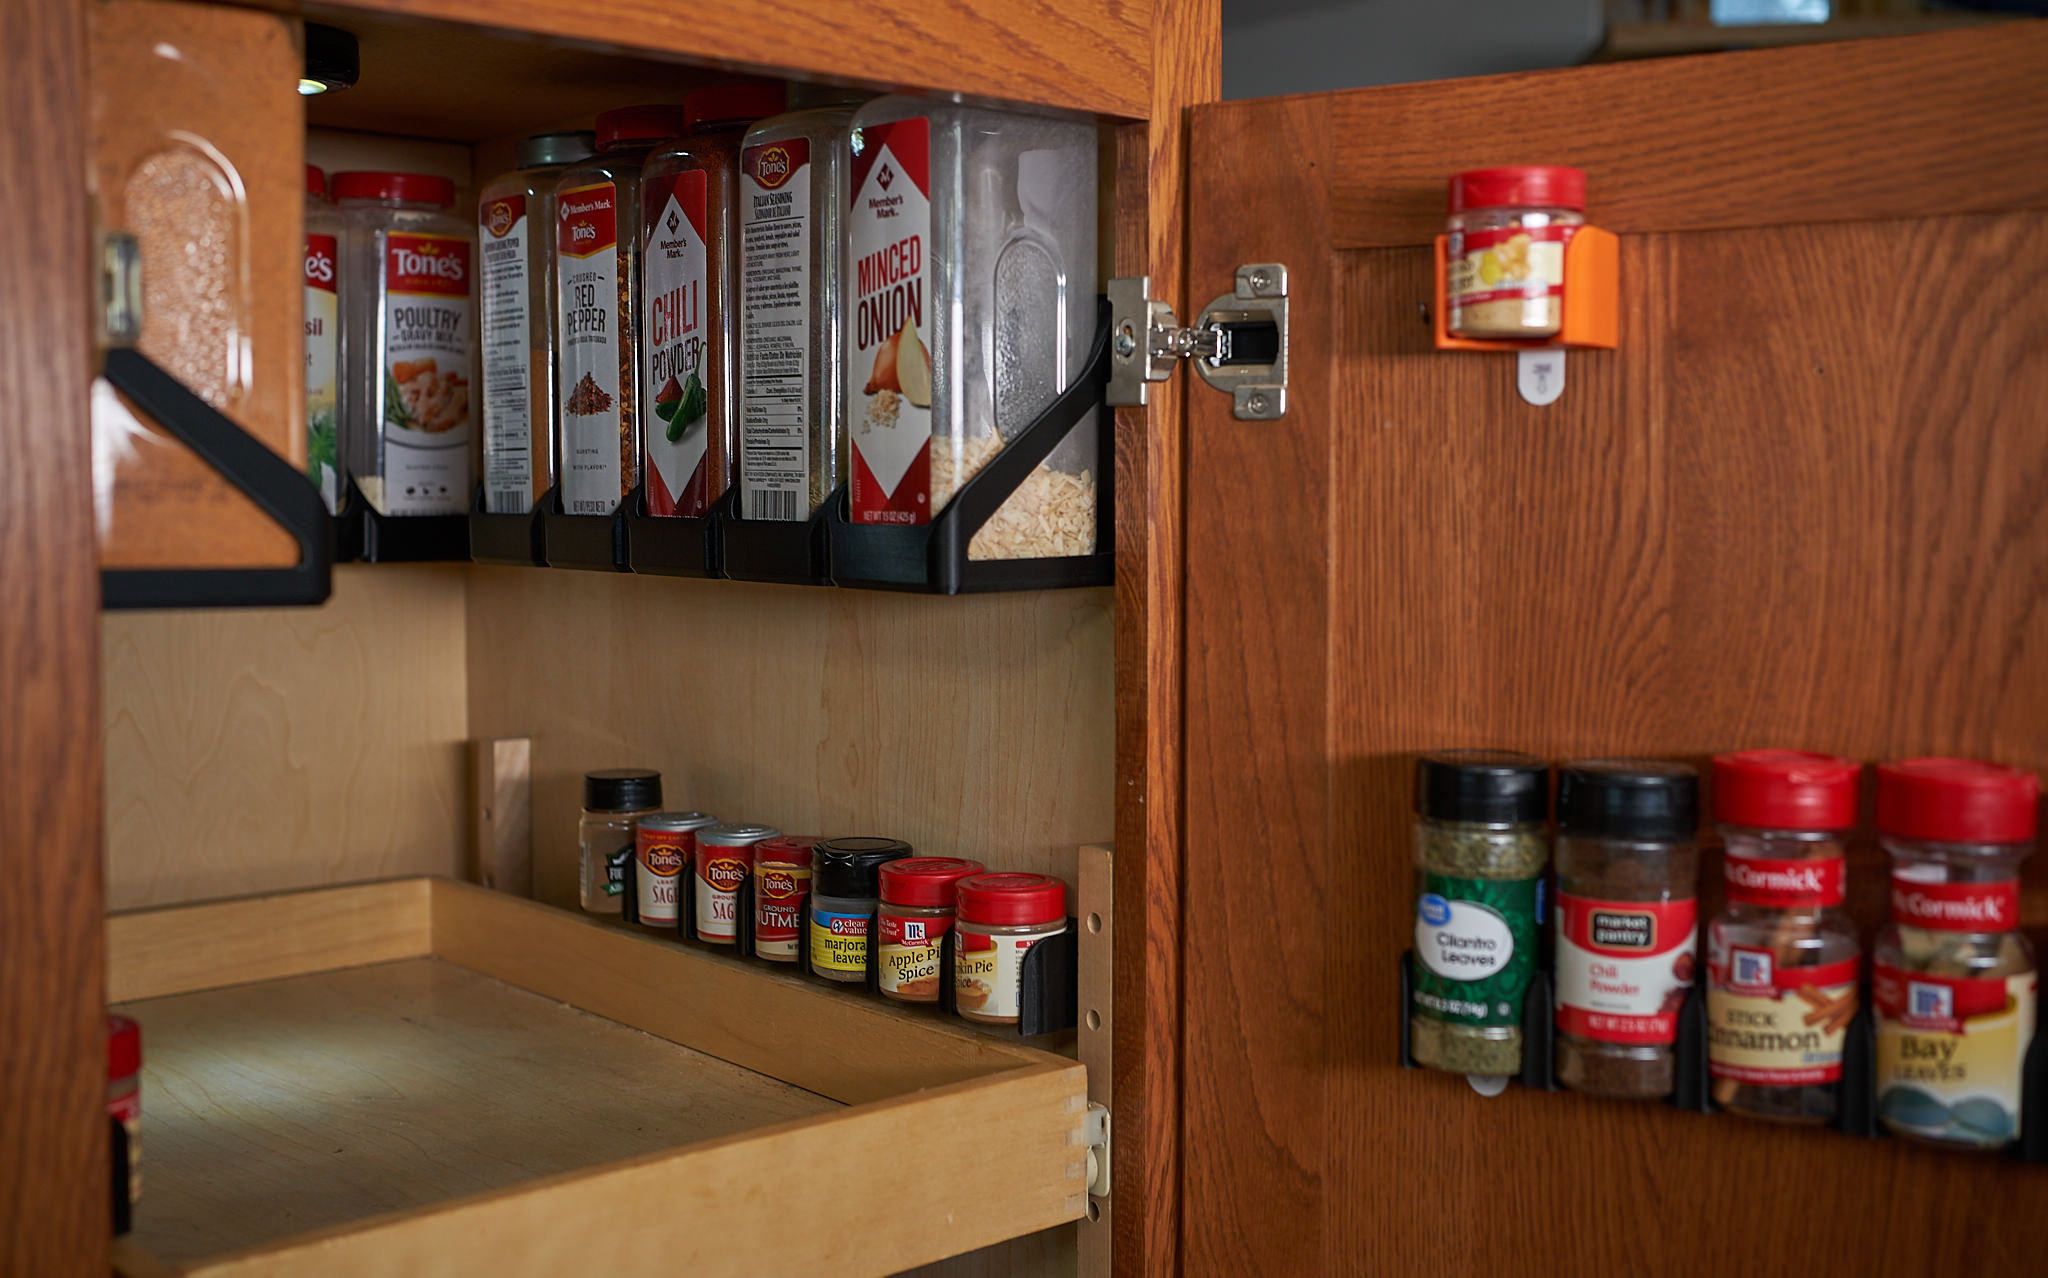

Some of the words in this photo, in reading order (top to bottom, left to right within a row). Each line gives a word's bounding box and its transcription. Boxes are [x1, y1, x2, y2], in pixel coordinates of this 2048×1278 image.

[761, 159, 786, 177] Tone's
[570, 202, 594, 215] Member's
[868, 194, 904, 209] Member's
[572, 224, 596, 242] Tone's
[660, 238, 687, 250] Member's
[305, 252, 333, 282] e's
[391, 248, 463, 281] Tone's
[858, 234, 921, 299] MINCED
[572, 271, 597, 285] CRUSHED
[574, 283, 595, 308] RED
[394, 306, 461, 331] POULTRY
[567, 308, 606, 336] PEPPER
[653, 280, 698, 347] CHILI
[858, 277, 922, 351] ONION
[305, 318, 323, 336] sil
[652, 336, 700, 385] POWDER
[649, 853, 683, 866] Tone's
[710, 866, 744, 881] Tone's
[764, 878, 793, 891] Tone's
[712, 900, 734, 920] SAG
[763, 904, 795, 913] GROUND
[756, 910, 800, 928] NUTME
[844, 919, 866, 928] clear
[1595, 915, 1648, 929] market
[824, 938, 866, 952] marjora
[1436, 931, 1497, 951] Cilantro
[1595, 928, 1648, 946] pantry
[832, 950, 868, 964] leaves
[889, 951, 924, 970] Apple
[927, 946, 940, 961] Pi
[1441, 949, 1496, 967] Leaves
[898, 965, 935, 982] Spice
[975, 960, 993, 974] Pie
[1589, 963, 1619, 978] Chili
[1589, 978, 1640, 996] Powder
[1727, 1008, 1775, 1028] STICK
[1902, 1036, 1957, 1060] Bay
[1894, 1063, 1967, 1081] LEAVES
